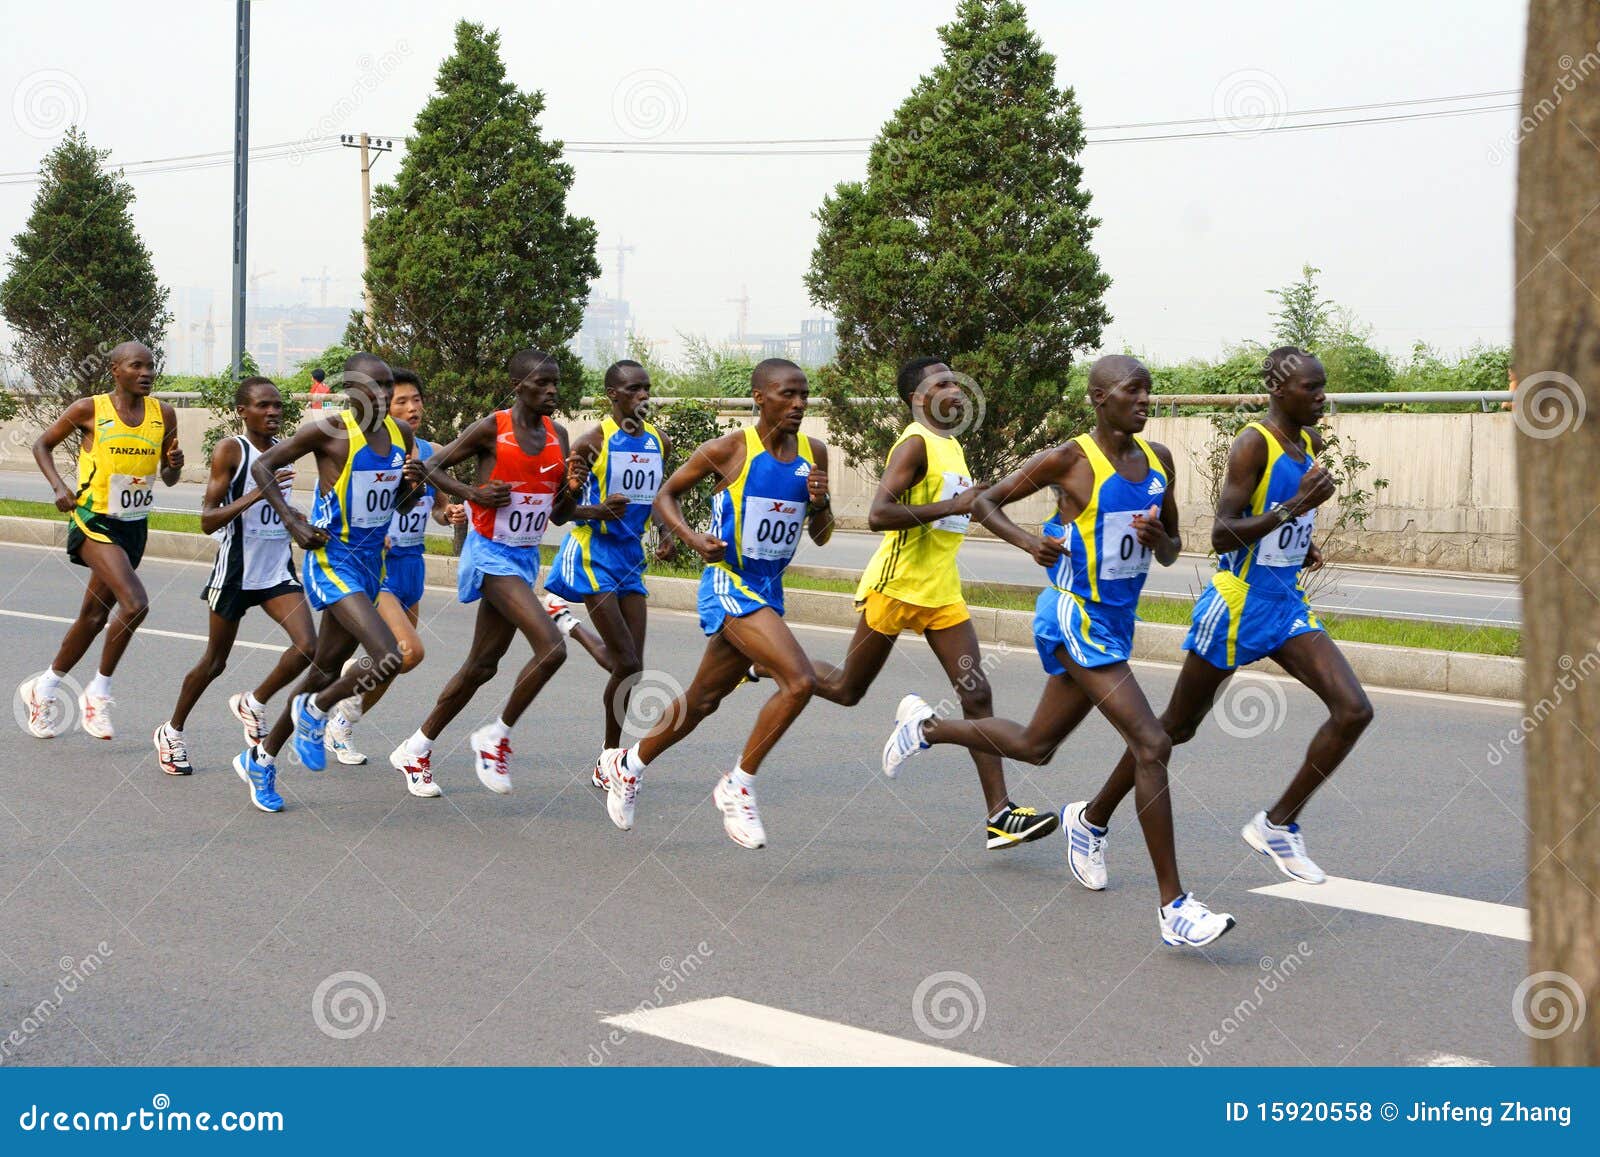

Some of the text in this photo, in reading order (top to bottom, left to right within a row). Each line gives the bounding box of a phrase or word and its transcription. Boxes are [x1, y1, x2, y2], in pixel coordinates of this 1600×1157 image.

[109, 447, 156, 456] TANZANIA
[622, 468, 655, 491] 001
[121, 489, 153, 509] 006
[399, 512, 428, 533] 021
[509, 510, 546, 533] 010
[757, 518, 799, 545] 008
[1278, 523, 1312, 550] 013
